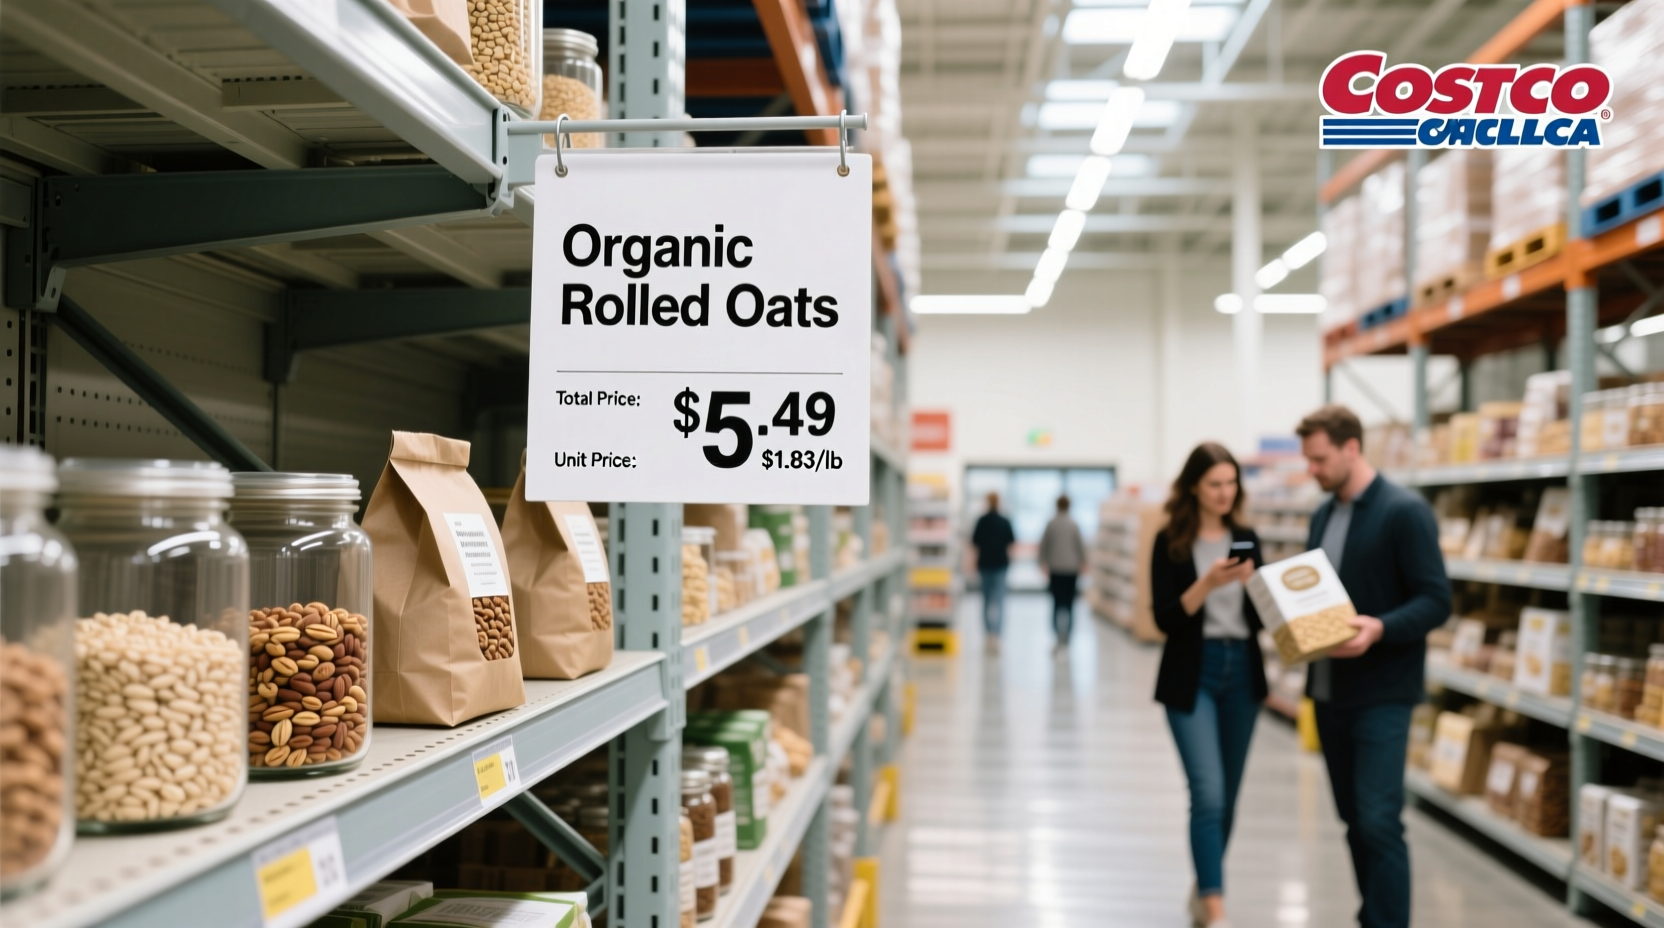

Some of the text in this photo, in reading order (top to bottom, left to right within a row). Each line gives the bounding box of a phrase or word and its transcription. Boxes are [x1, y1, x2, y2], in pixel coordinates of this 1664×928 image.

[563, 224, 753, 278] Organic
[562, 283, 838, 328] Rolled Oats
[556, 390, 641, 407] Total Price:
[673, 387, 836, 469] $5.49
[554, 452, 637, 469] Unit Price:
[761, 449, 843, 473] $1.83/lb
